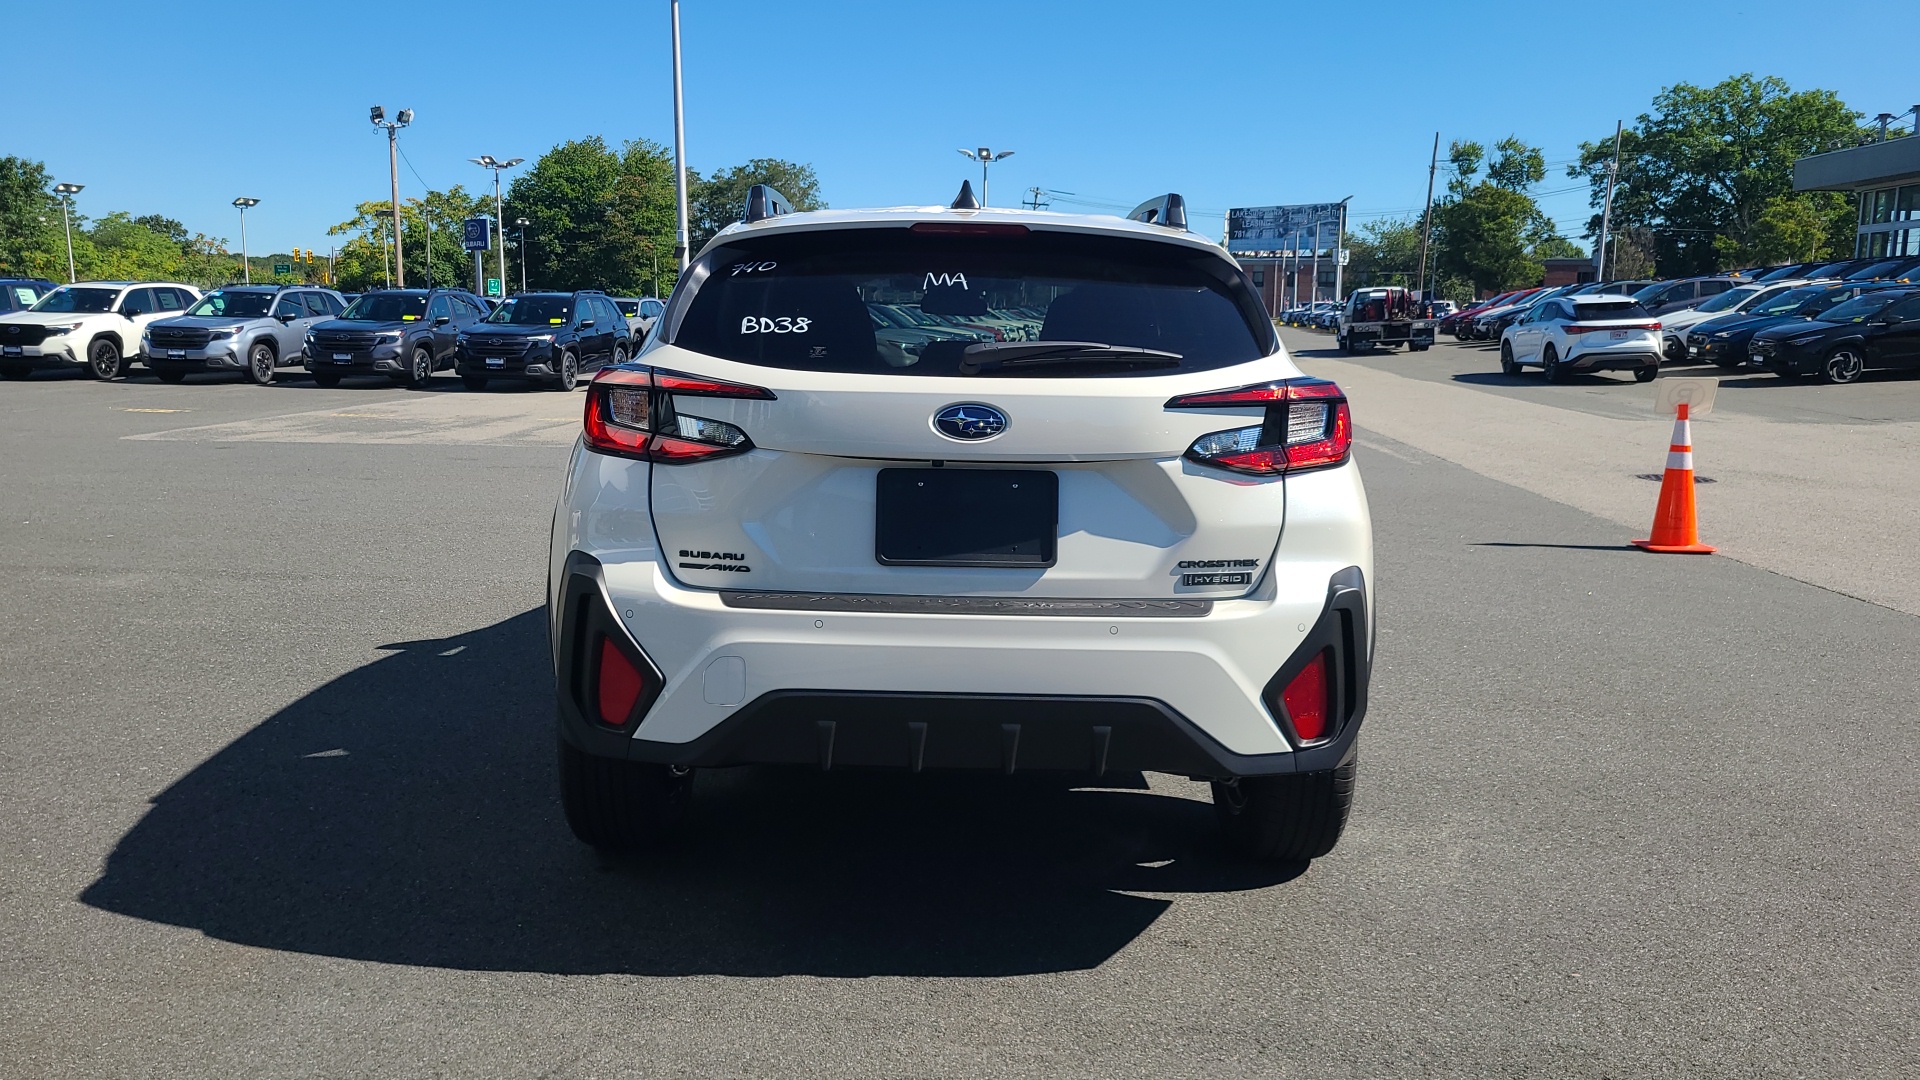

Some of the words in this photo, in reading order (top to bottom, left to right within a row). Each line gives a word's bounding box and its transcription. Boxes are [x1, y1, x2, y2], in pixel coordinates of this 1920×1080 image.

[923, 272, 969, 290] MA
[741, 316, 812, 334] BD38
[679, 550, 745, 561] SUBARU
[705, 564, 751, 572] AWD
[1178, 559, 1260, 568] CROSSTREK
[1194, 575, 1242, 583] HYBRID
